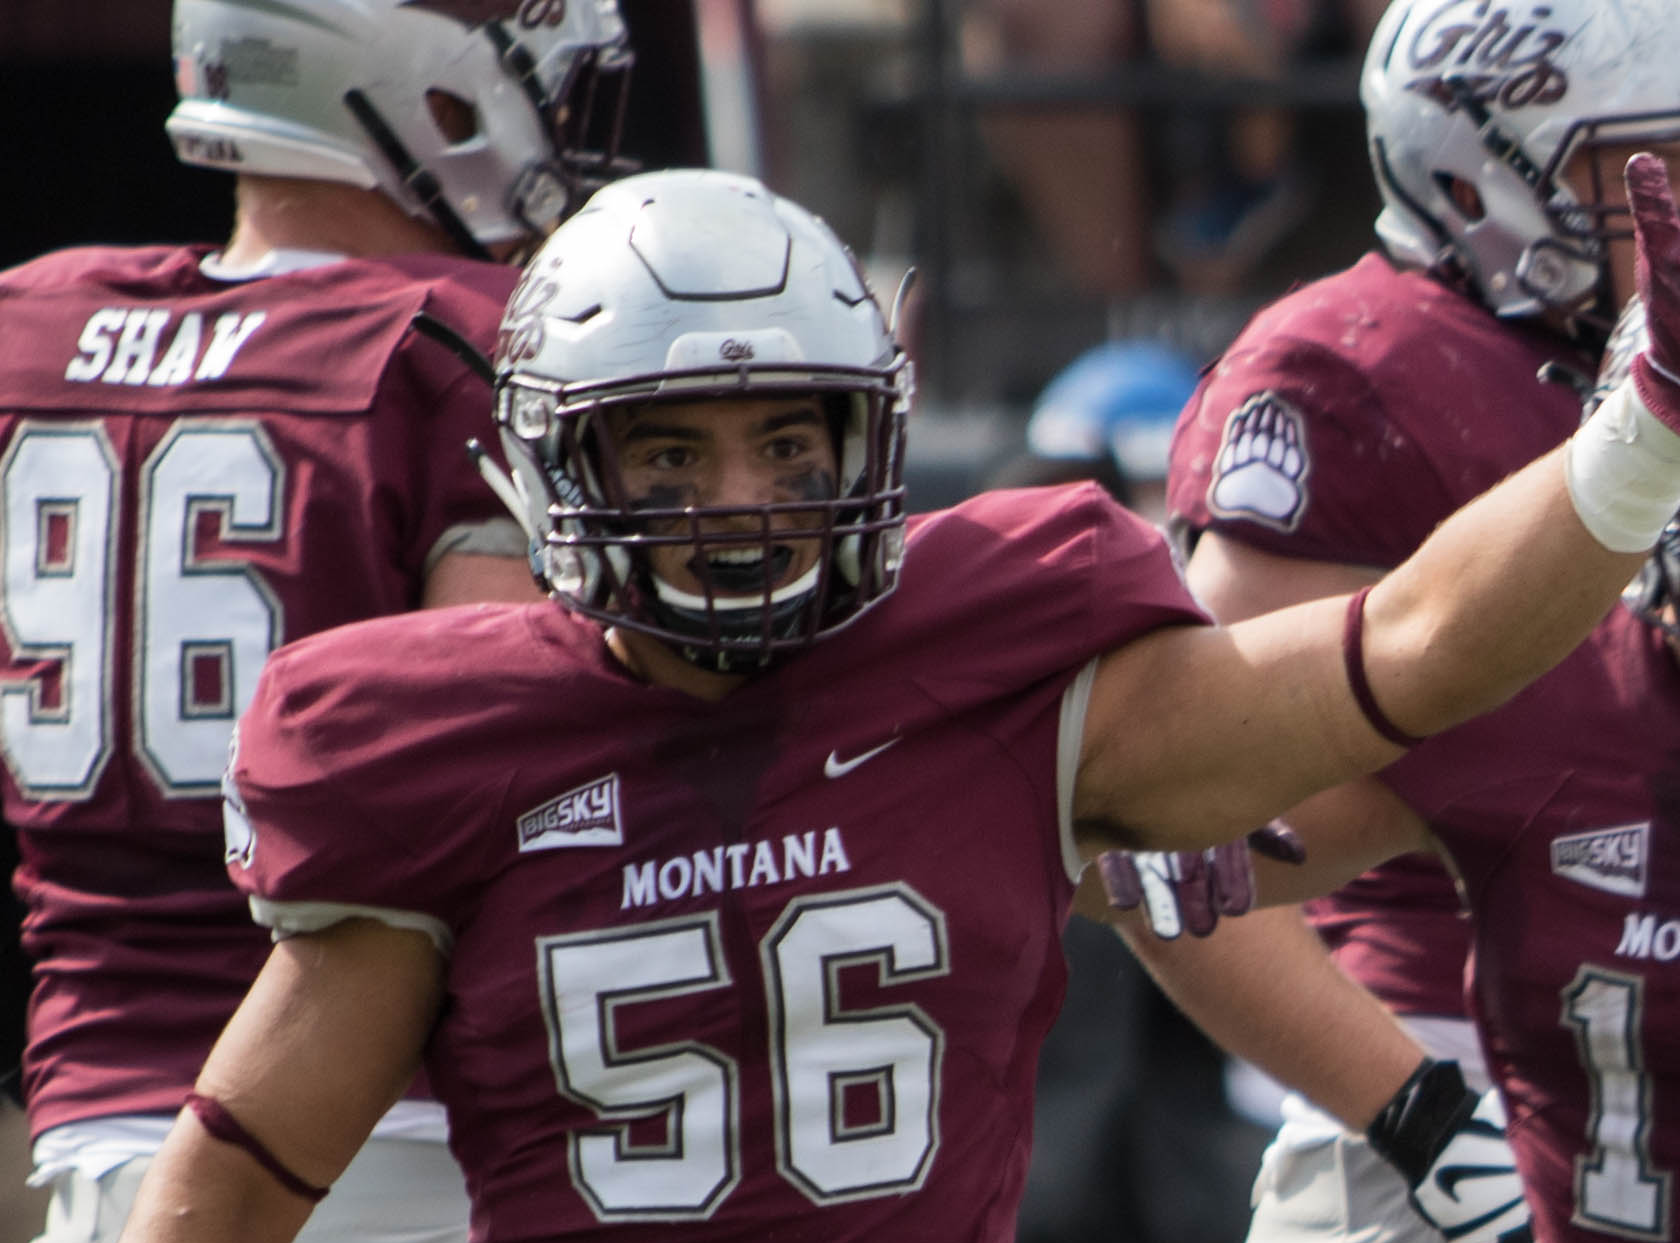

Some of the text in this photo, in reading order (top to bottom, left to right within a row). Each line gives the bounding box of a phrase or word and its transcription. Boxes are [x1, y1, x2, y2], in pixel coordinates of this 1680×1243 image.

[1404, 0, 1568, 113] Griz
[64, 308, 266, 386] SHAW
[0, 418, 286, 801] 96
[620, 828, 850, 910] MONTANA
[536, 881, 950, 1223] 56
